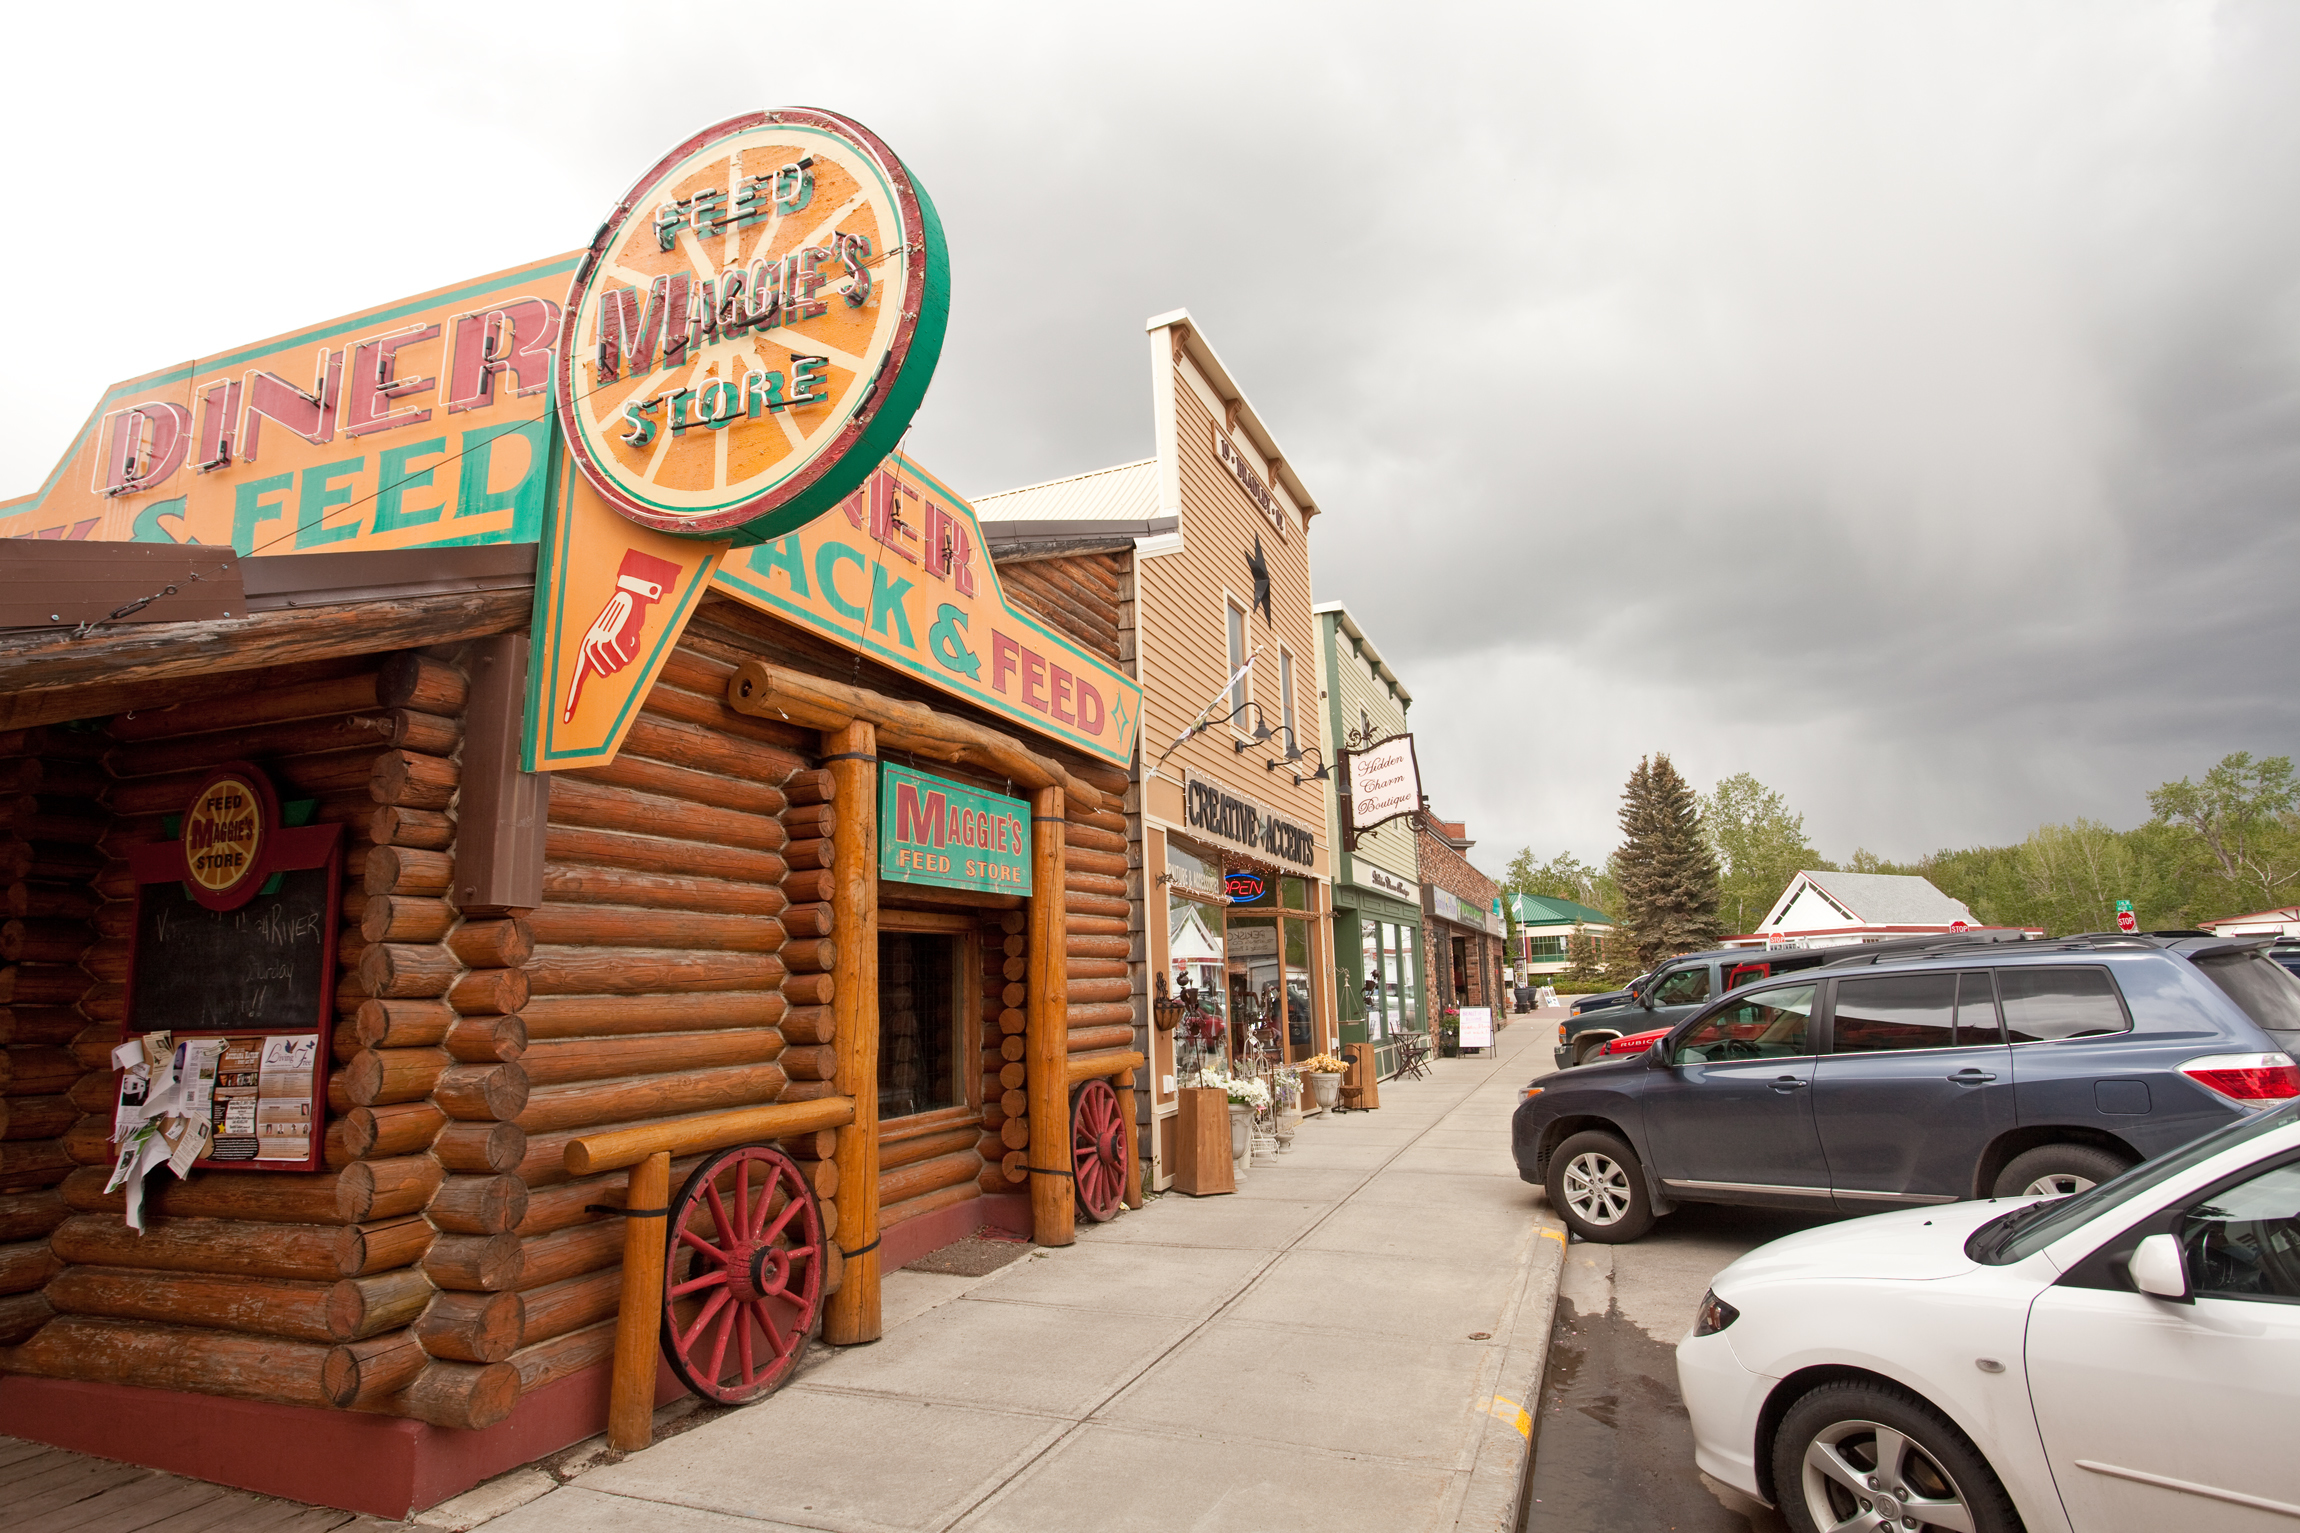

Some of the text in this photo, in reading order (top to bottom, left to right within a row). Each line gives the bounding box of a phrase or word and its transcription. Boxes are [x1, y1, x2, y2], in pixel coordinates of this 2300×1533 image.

[652, 158, 815, 252] FEED
[595, 231, 873, 387] MAGGIE'S
[91, 295, 562, 499] DINER
[620, 353, 830, 447] STORE
[233, 419, 545, 557] FEED
[746, 532, 1105, 737] ACK & FEED
[1358, 755, 1405, 778] Hidden
[1359, 775, 1405, 794] Charm
[207, 795, 242, 811] FEED
[895, 782, 1023, 857] MAGGIE'S
[1357, 792, 1412, 815] Boutique
[191, 817, 254, 850] MAGGIE'S
[1188, 779, 1314, 867] CREATIVE ACCENTS
[197, 852, 244, 870] STORE
[898, 848, 1022, 884] FEED STORE
[1951, 925, 1968, 934] STOP
[2118, 917, 2133, 926] STOP
[265, 1043, 294, 1063] Living
[295, 1048, 312, 1068] Free
[1620, 1039, 1654, 1047] RUBIC
